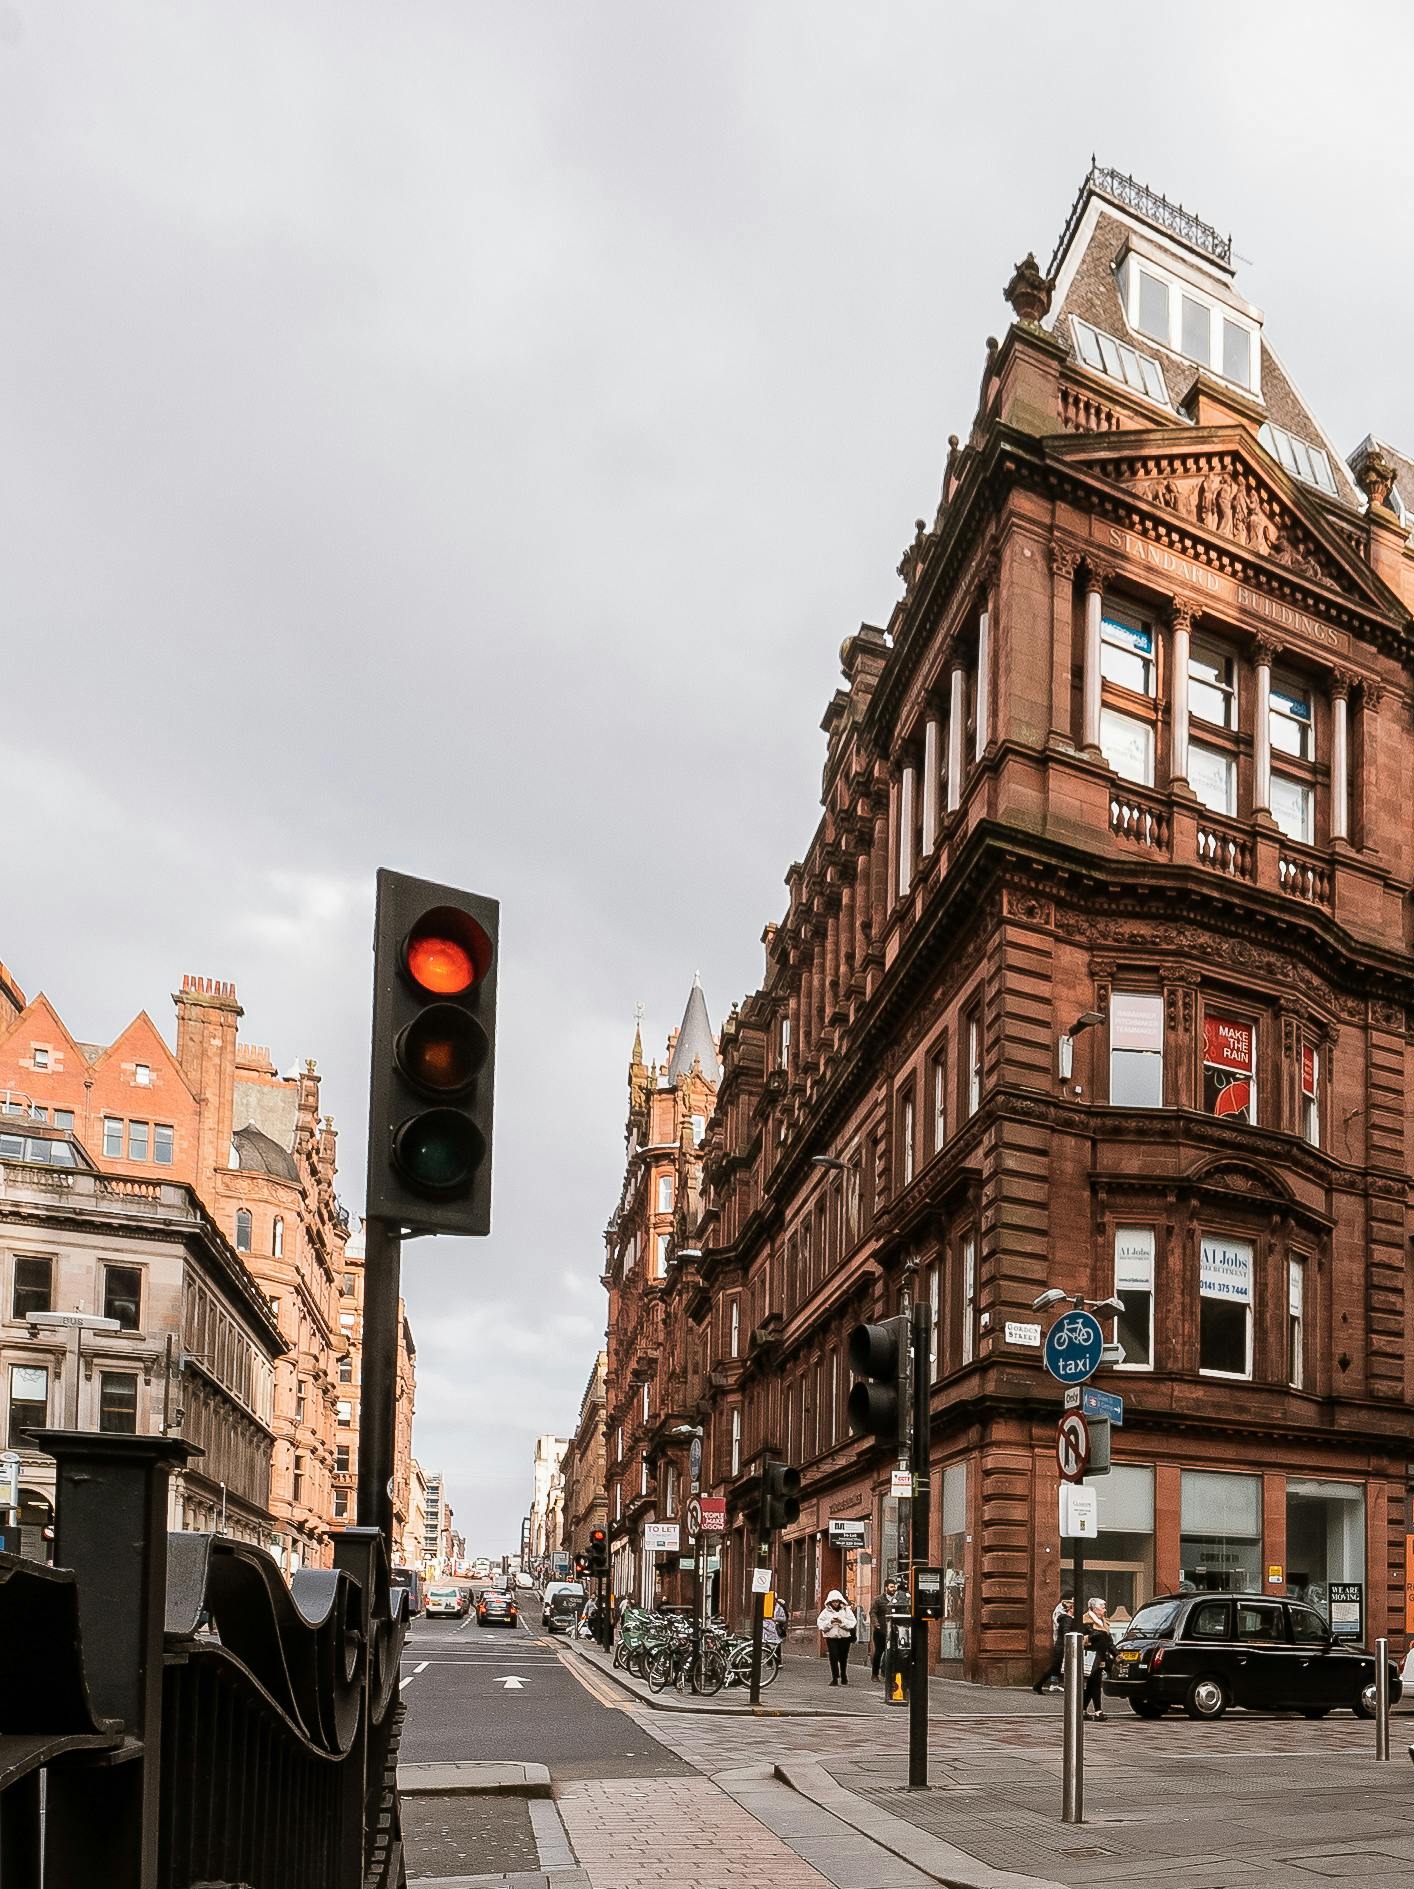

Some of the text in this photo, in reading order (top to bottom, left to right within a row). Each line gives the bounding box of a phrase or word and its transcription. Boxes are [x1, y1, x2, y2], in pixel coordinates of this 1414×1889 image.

[1109, 528, 1338, 646] STANDARD BUILDINGS
[1219, 1025, 1249, 1043] MAKE
[1228, 1038, 1249, 1054] THE
[1223, 1047, 1249, 1064] RAIN
[1132, 1248, 1150, 1257] Jobs
[1219, 1249, 1248, 1269] Jobs
[1200, 1279, 1248, 1296] 0141 375 7444
[62, 1317, 84, 1326] BUS
[1007, 1323, 1039, 1334] GORDON
[1008, 1331, 1038, 1341] STREET
[1058, 1353, 1090, 1375] taxi
[1066, 1391, 1079, 1404] Only
[702, 1511, 725, 1519] PEOPLE
[647, 1525, 660, 1533] TO
[1331, 1586, 1359, 1595] WE ARE
[1331, 1593, 1360, 1601] MOVING
